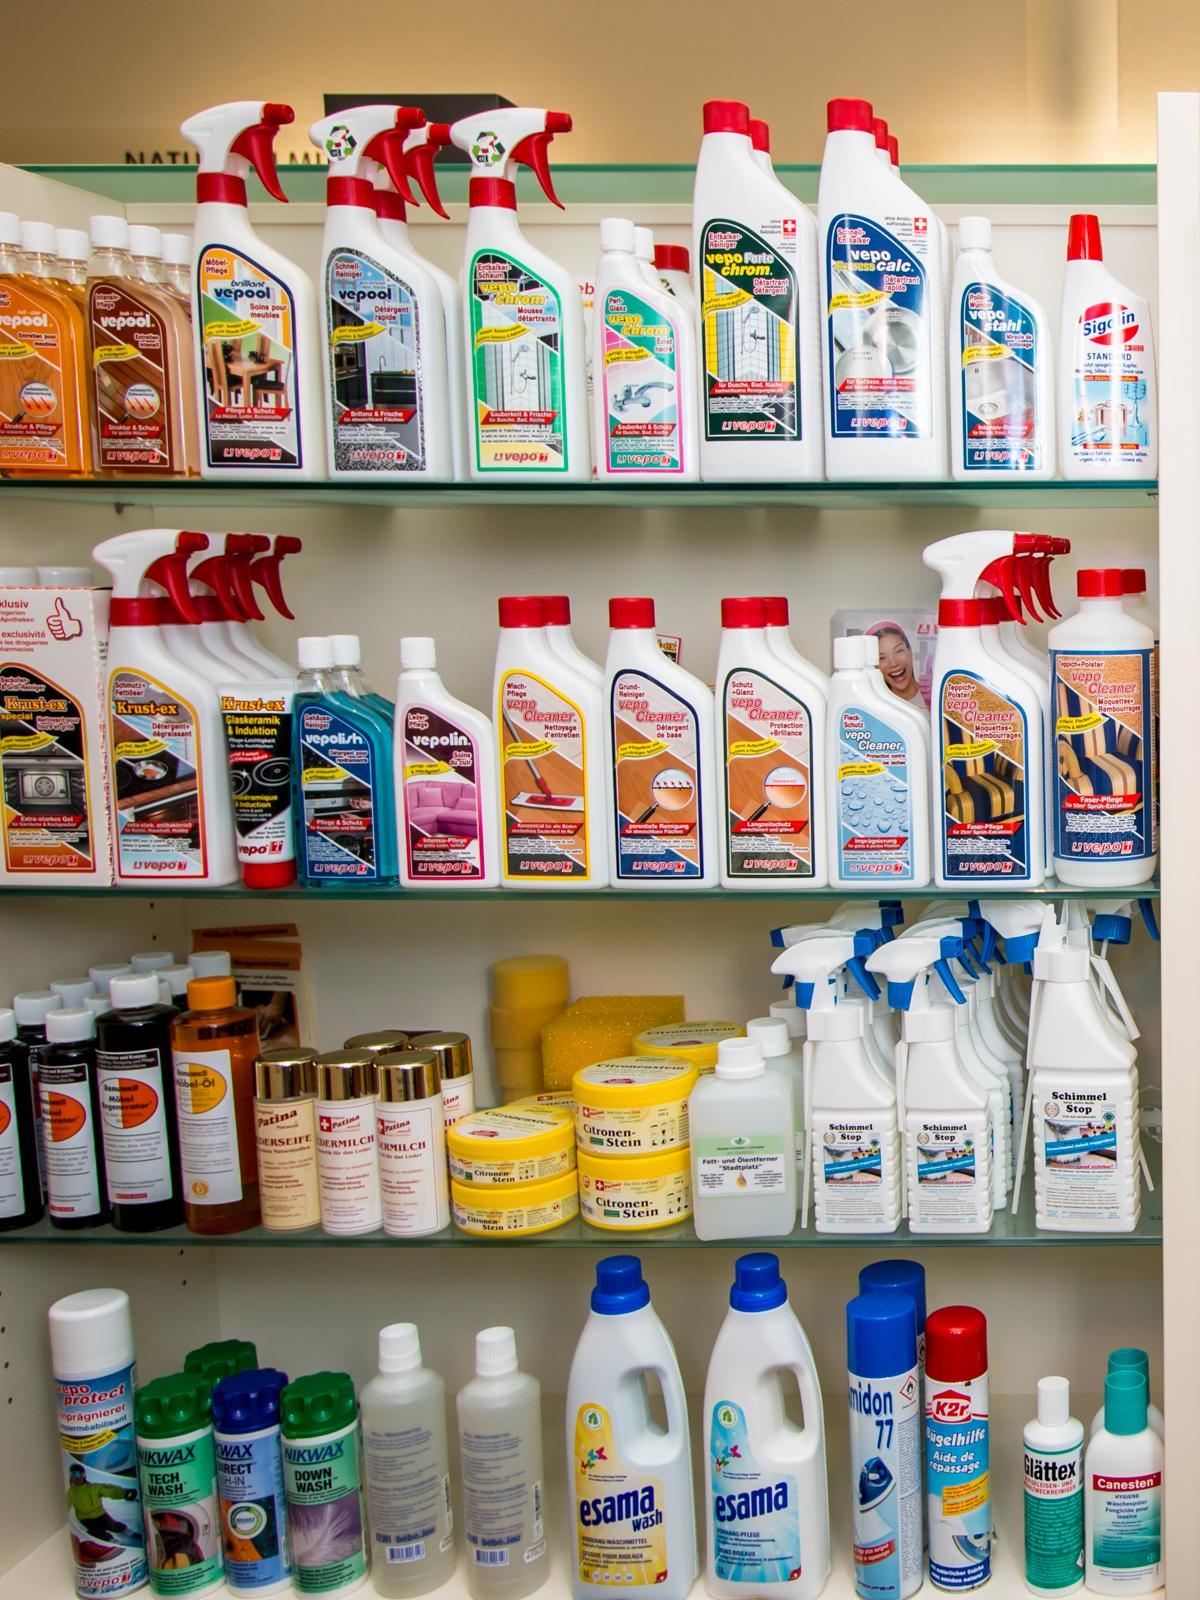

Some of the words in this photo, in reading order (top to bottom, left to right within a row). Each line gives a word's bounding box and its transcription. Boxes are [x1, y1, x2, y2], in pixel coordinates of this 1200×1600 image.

[707, 253, 743, 265] vepo
[745, 253, 774, 263] Forte
[850, 250, 891, 263] vepo
[214, 287, 271, 300] vepool
[480, 282, 517, 294] vepo
[339, 288, 391, 302] vepool
[496, 295, 545, 305] chrom
[608, 314, 643, 325] vepo
[969, 310, 1005, 321] vepo
[622, 325, 669, 336] chrom
[983, 320, 1022, 332] stahl
[1072, 671, 1101, 684] vepo
[1088, 683, 1136, 694] Cleaner
[5, 697, 66, 711] Krust-ex
[116, 702, 177, 715] Krust-ex
[222, 697, 285, 711] Krust-ex
[506, 700, 537, 711] vepo
[619, 701, 649, 712] vepo
[732, 698, 761, 710] vepo
[947, 700, 977, 711] vepo
[524, 711, 575, 722] Cleaner
[636, 711, 687, 722] Cleaner
[749, 709, 800, 720] Cleaner
[965, 711, 1014, 721] Cleaner
[226, 716, 280, 725] Glaskeramik
[236, 726, 277, 735] Induktion
[544, 725, 577, 733] Nettoyage
[305, 733, 363, 746] vepolish
[844, 731, 871, 741] vepo
[858, 741, 901, 750] Cleaner
[1052, 1092, 1107, 1102] Schimmel
[1066, 1104, 1092, 1114] Stop
[258, 1110, 297, 1127] Patina
[583, 1124, 635, 1137] Citronen-
[606, 1138, 642, 1147] Stein
[596, 1197, 653, 1208] Citronen-
[623, 1208, 659, 1218] Stein
[63, 1385, 125, 1406] protect
[935, 1401, 969, 1416] K2r
[876, 1419, 893, 1449] 77
[284, 1441, 344, 1462] NIKWAX
[934, 1451, 957, 1462] Aide
[961, 1452, 974, 1461] de
[1024, 1453, 1076, 1480] Glättex
[149, 1473, 180, 1484] TECH
[294, 1467, 332, 1481] DOWN
[148, 1484, 184, 1495] WASH
[296, 1478, 332, 1492] WASH
[1097, 1478, 1154, 1490] Canesten
[580, 1486, 655, 1528] esama
[715, 1482, 787, 1522] esama
[631, 1509, 662, 1532] wash
